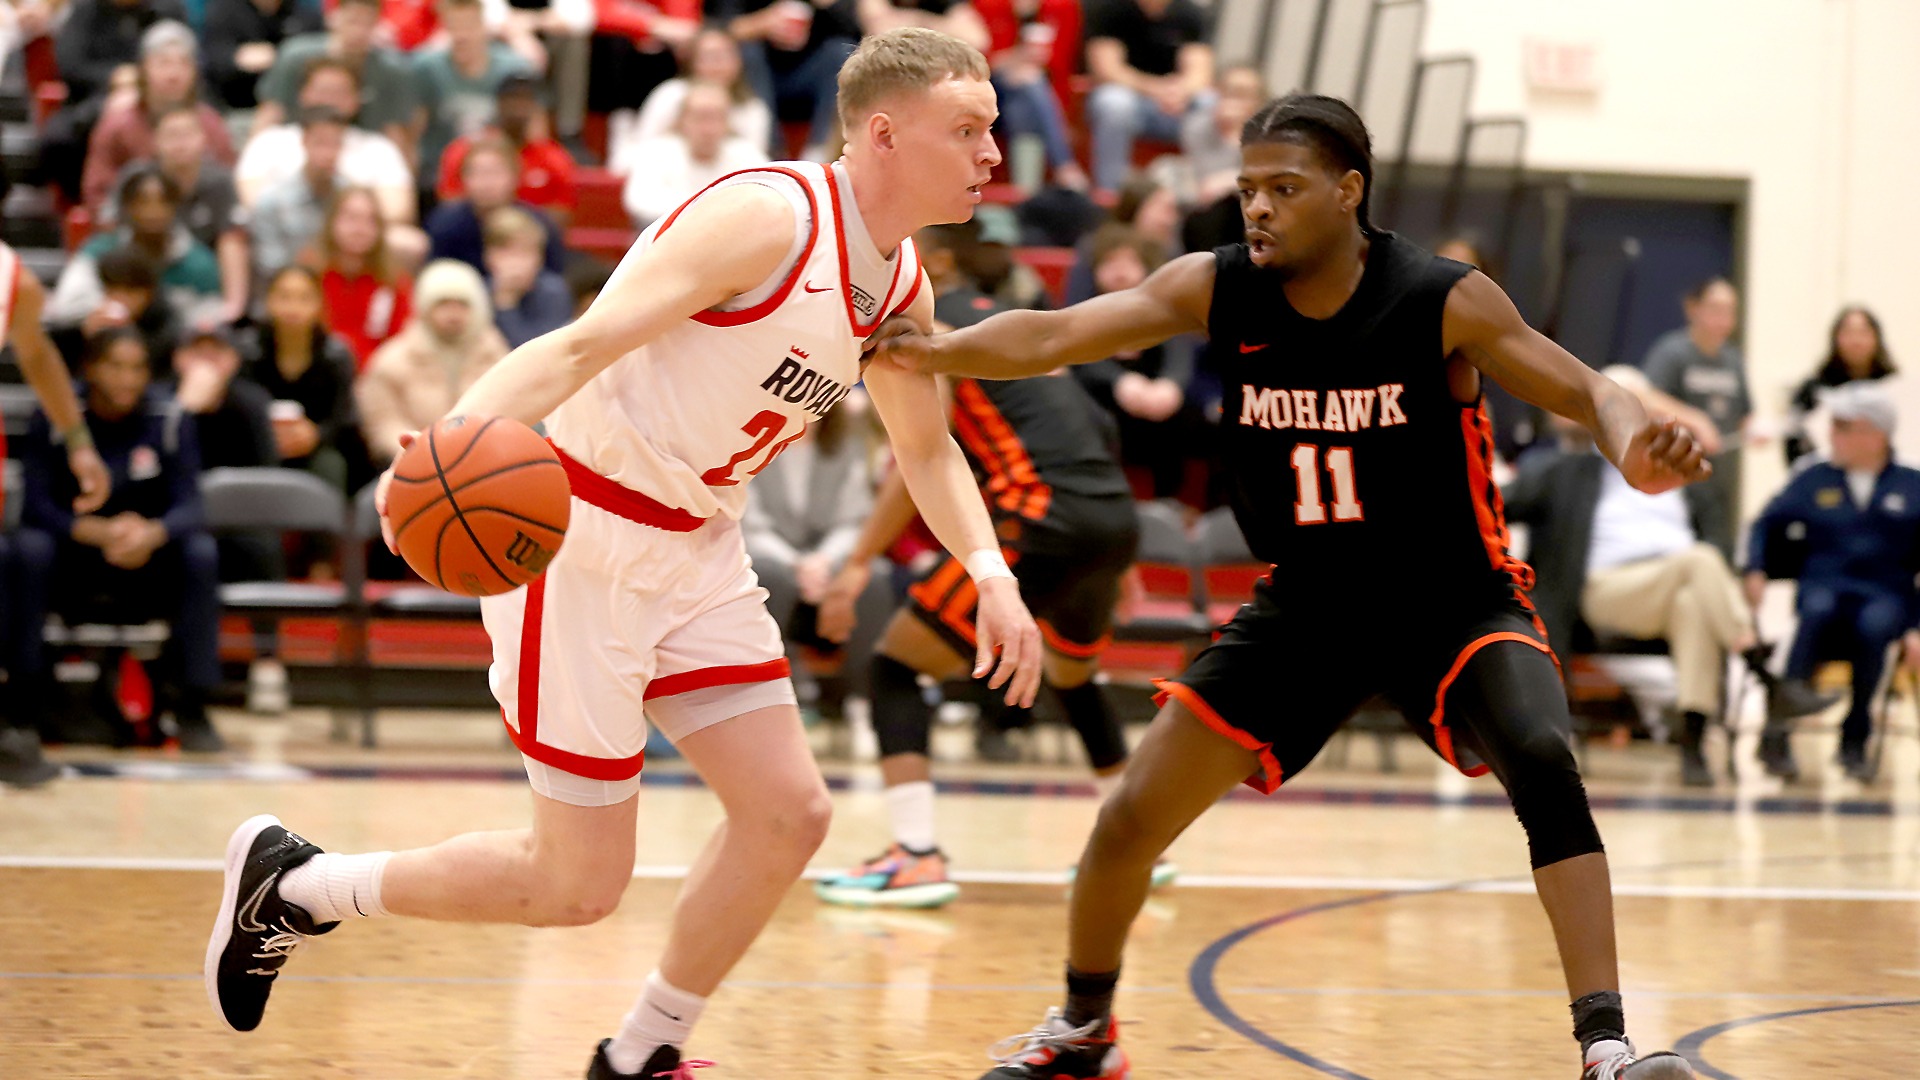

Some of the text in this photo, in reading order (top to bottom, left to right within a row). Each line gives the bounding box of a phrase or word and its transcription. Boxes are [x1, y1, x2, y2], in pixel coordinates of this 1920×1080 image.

[760, 357, 851, 416] ROYAL
[1239, 383, 1408, 432] MOHAWK
[1290, 442, 1365, 526] 11
